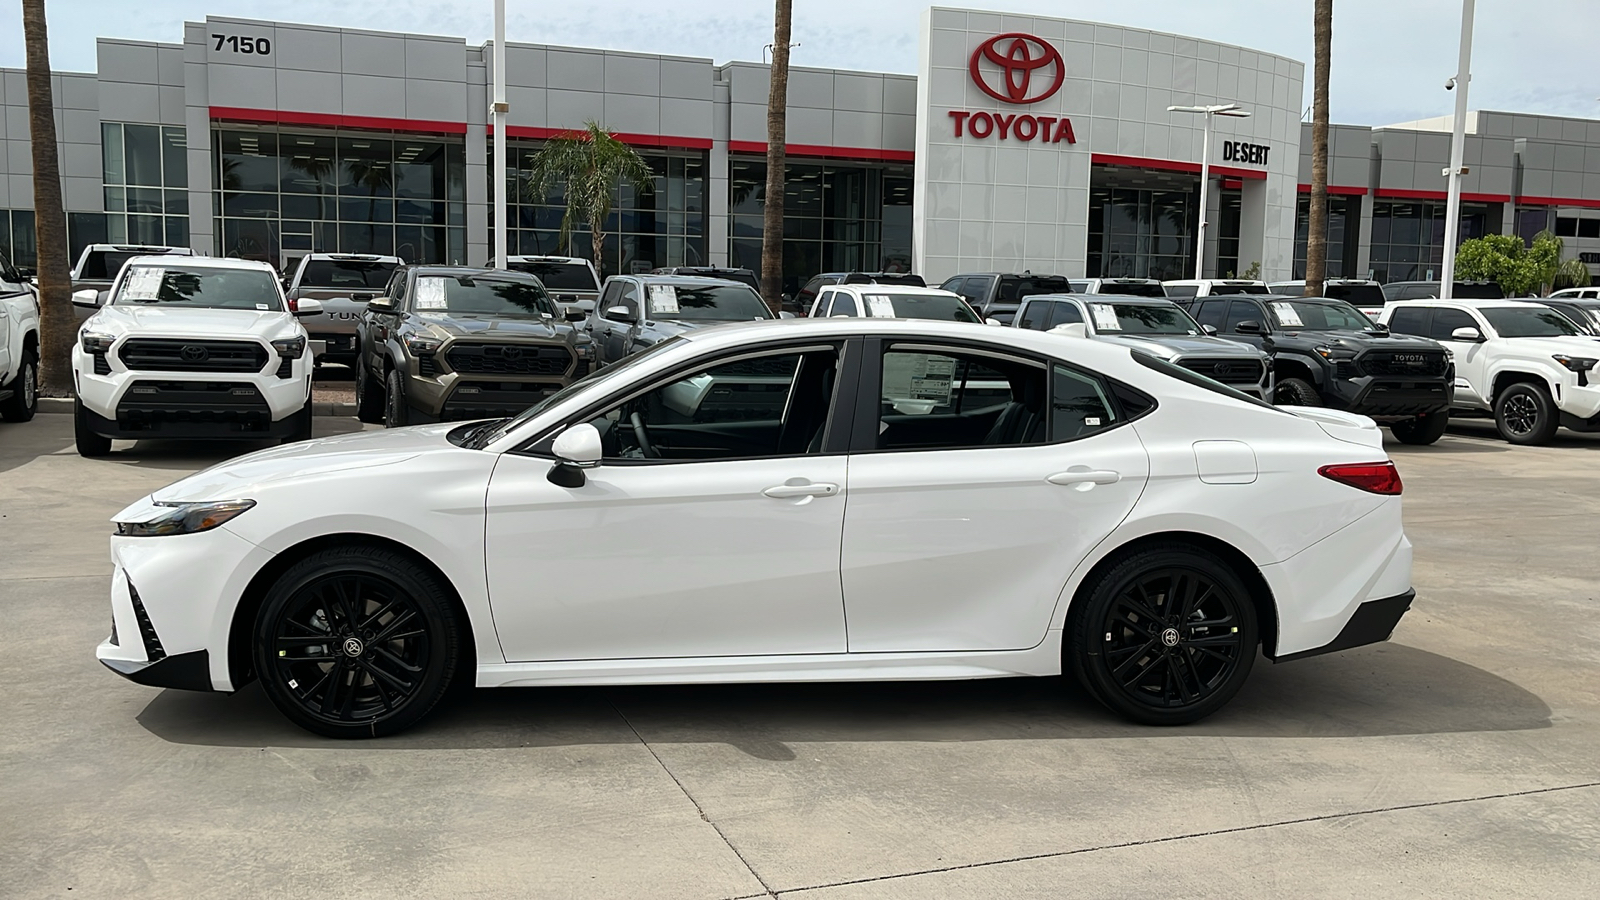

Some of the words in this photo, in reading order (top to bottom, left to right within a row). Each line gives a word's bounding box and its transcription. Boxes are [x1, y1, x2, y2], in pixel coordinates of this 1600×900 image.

[211, 33, 271, 56] 7150
[948, 110, 1077, 145] TOYOTA
[1223, 140, 1271, 166] DESERT
